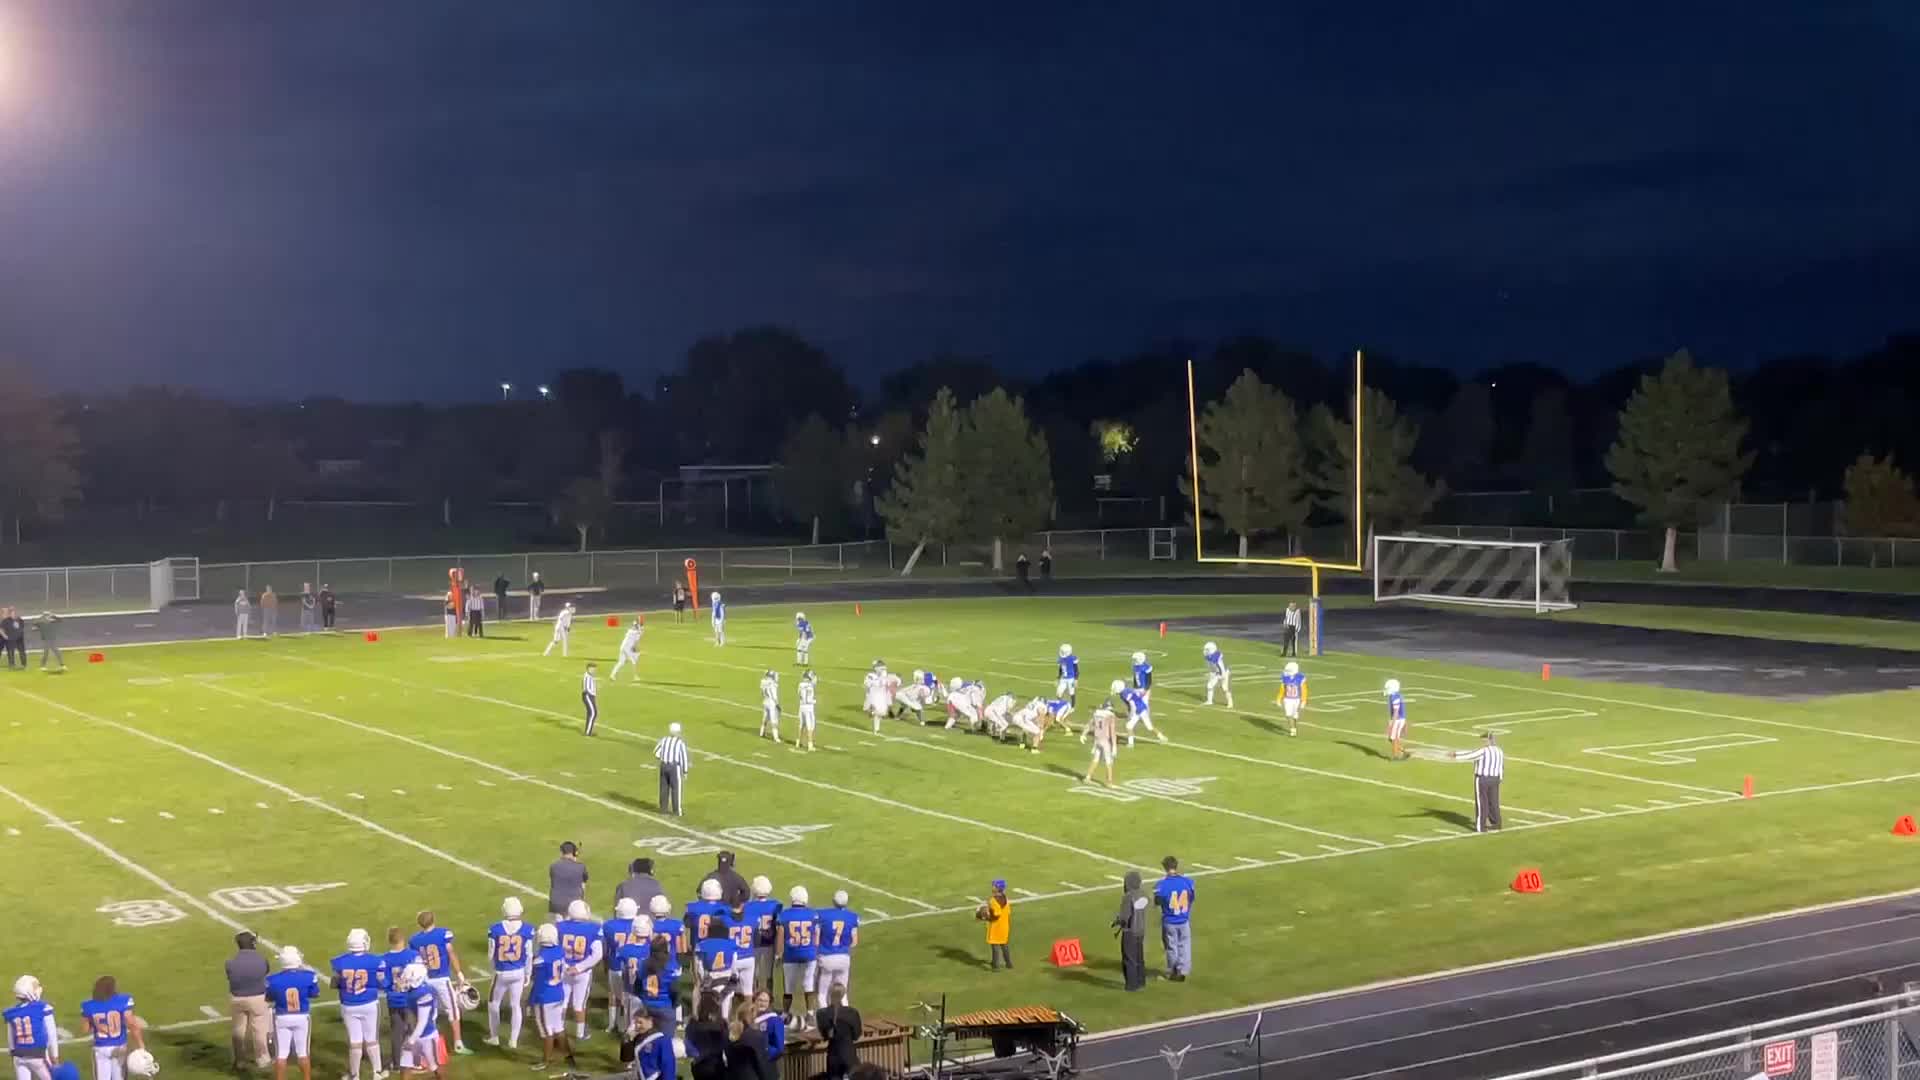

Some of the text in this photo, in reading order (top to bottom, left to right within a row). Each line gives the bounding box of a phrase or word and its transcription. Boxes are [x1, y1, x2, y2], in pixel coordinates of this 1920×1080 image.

[1523, 872, 1540, 890] 10
[1169, 889, 1189, 915] 44
[787, 920, 813, 947] 55
[831, 920, 846, 947] 7
[498, 934, 523, 962] 23
[711, 950, 726, 971] 4
[1058, 943, 1080, 964] 20
[342, 968, 369, 996] 72
[14, 1015, 35, 1045] 11
[92, 1010, 122, 1039] 50
[1767, 1044, 1793, 1065] EXIT
